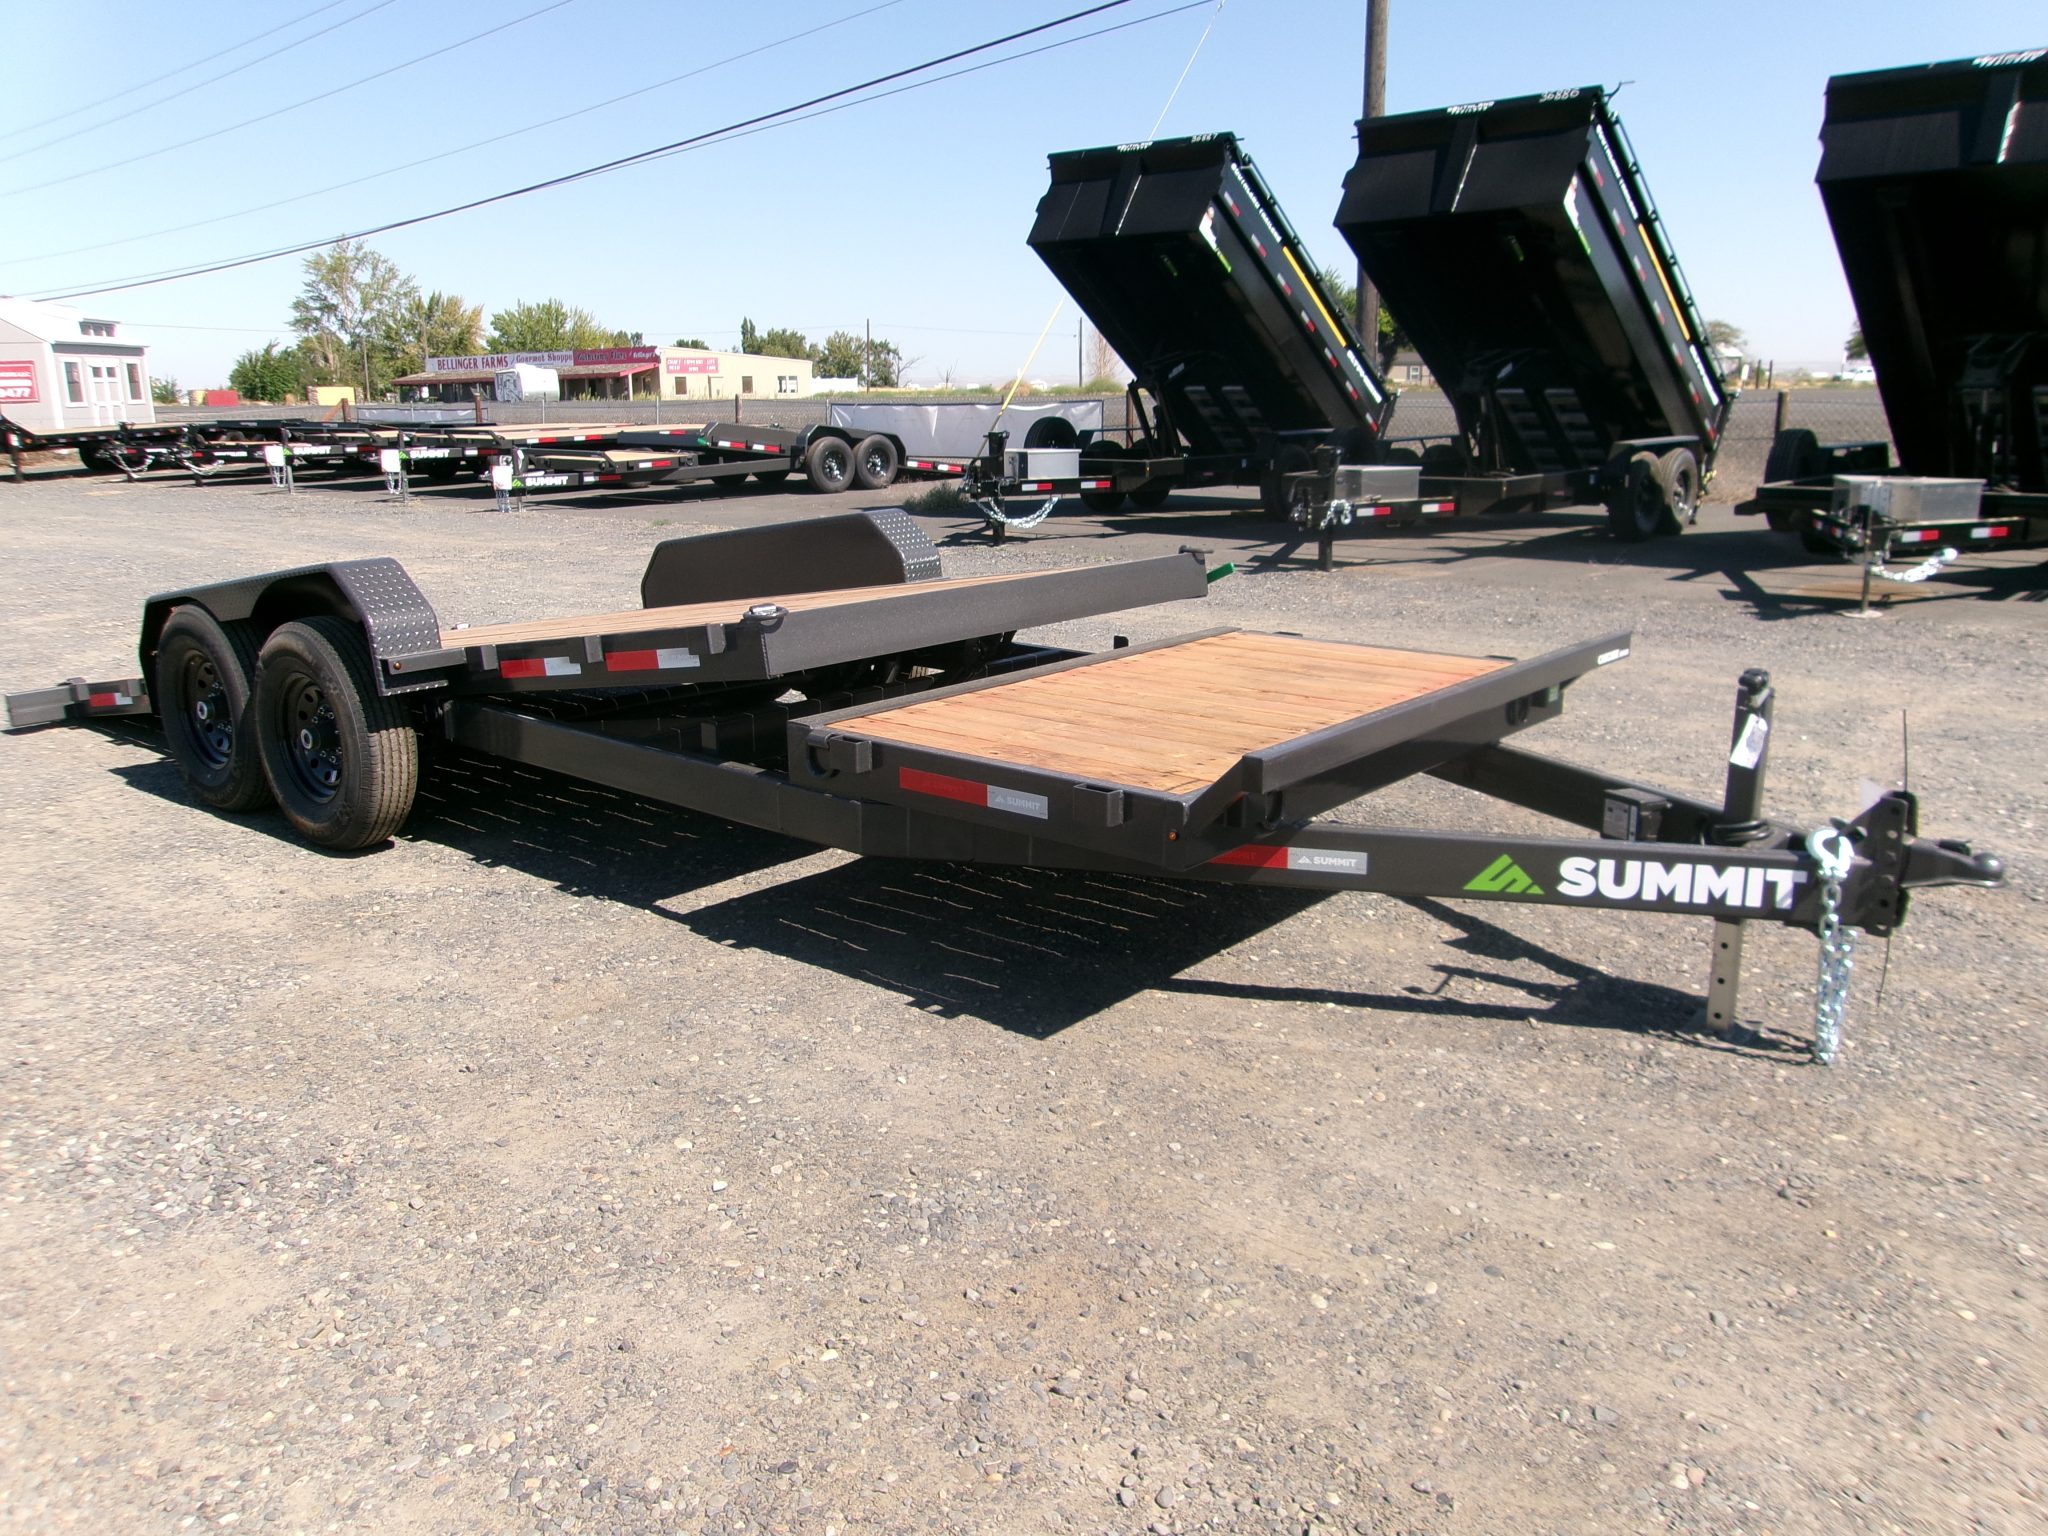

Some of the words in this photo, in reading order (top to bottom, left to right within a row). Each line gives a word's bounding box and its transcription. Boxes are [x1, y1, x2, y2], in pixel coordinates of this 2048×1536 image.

[437, 357, 479, 371] BELLINGER
[481, 355, 509, 369] FARMS
[516, 354, 545, 363] Gourmet
[525, 476, 569, 487] SUMMIT
[1007, 796, 1041, 811] SUMMIT
[1313, 856, 1358, 867] SUMMIT
[1556, 856, 1808, 910] SUMMIT
